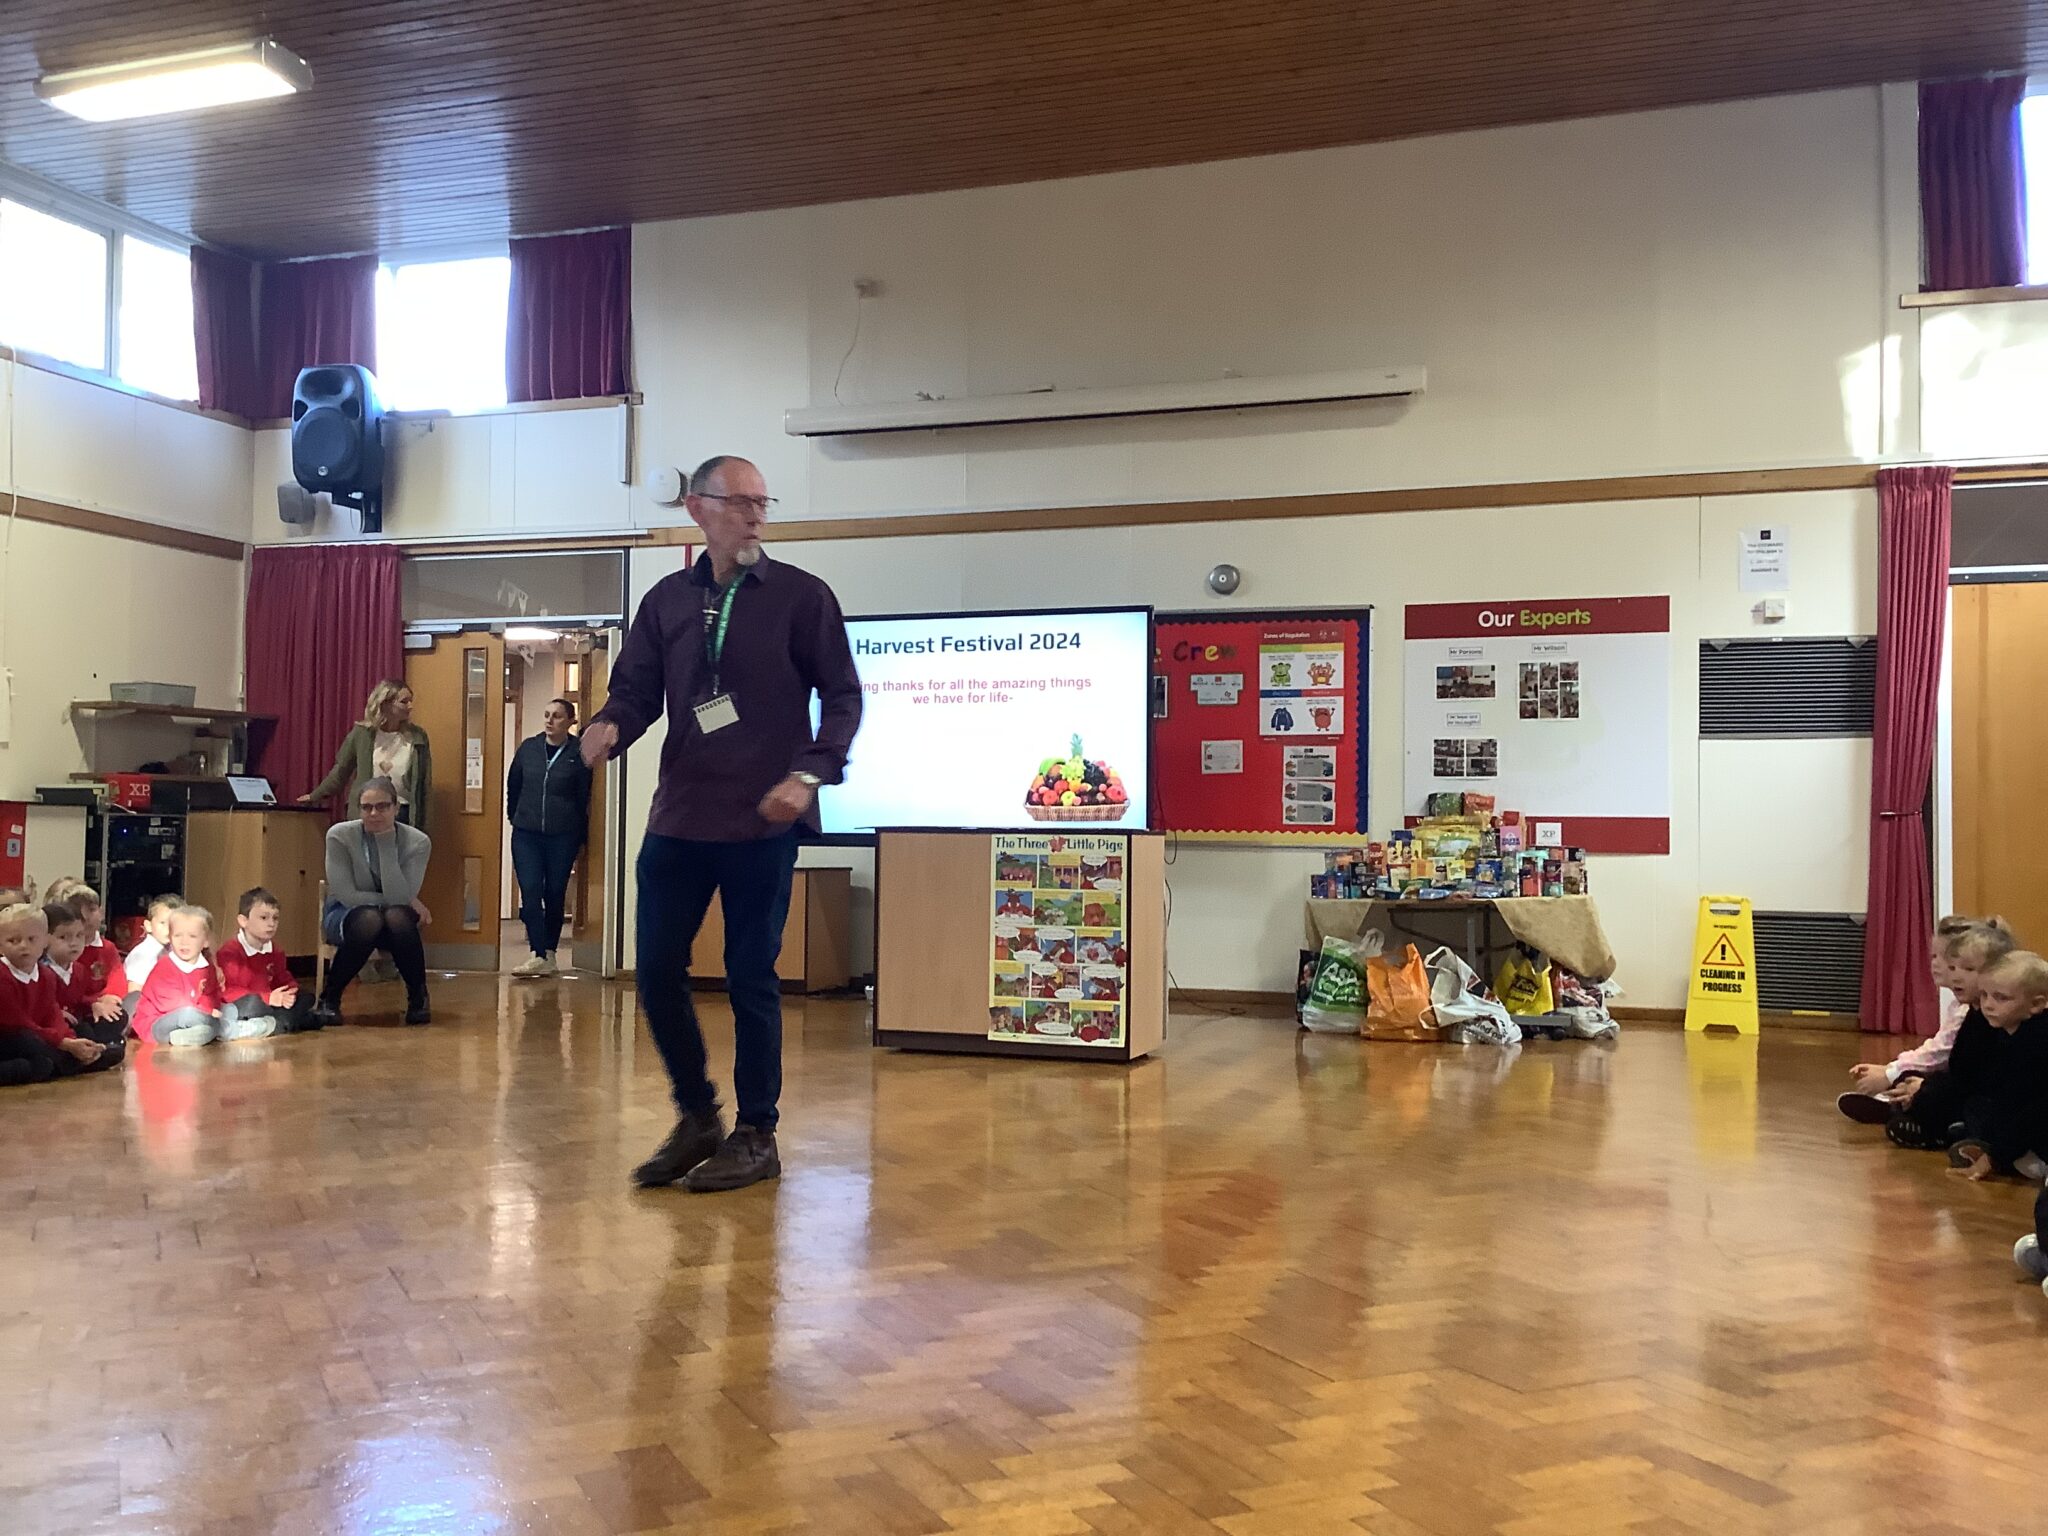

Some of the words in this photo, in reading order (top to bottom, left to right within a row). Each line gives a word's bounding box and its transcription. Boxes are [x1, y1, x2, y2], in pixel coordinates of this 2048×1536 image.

[1478, 611, 1515, 627] Our
[1520, 608, 1591, 630] Experts
[856, 637, 935, 655] Harvest
[941, 634, 1023, 652] Festival
[1030, 632, 1081, 650] 2024
[883, 680, 924, 692] thanks
[928, 680, 945, 691] for
[949, 679, 964, 690] all
[968, 679, 987, 690] the
[992, 678, 1046, 692] amazing
[1050, 677, 1091, 690] things
[912, 694, 930, 704] we
[934, 692, 963, 704] have
[968, 692, 985, 703] for
[989, 691, 1014, 703] life-
[995, 837, 1015, 849] The
[1017, 837, 1048, 849] Three
[1066, 838, 1094, 850] Little
[1098, 838, 1123, 853] Pigs
[1700, 968, 1736, 980] CLEANING
[1737, 971, 1746, 981] IN
[1703, 982, 1742, 994] PROGRESS
